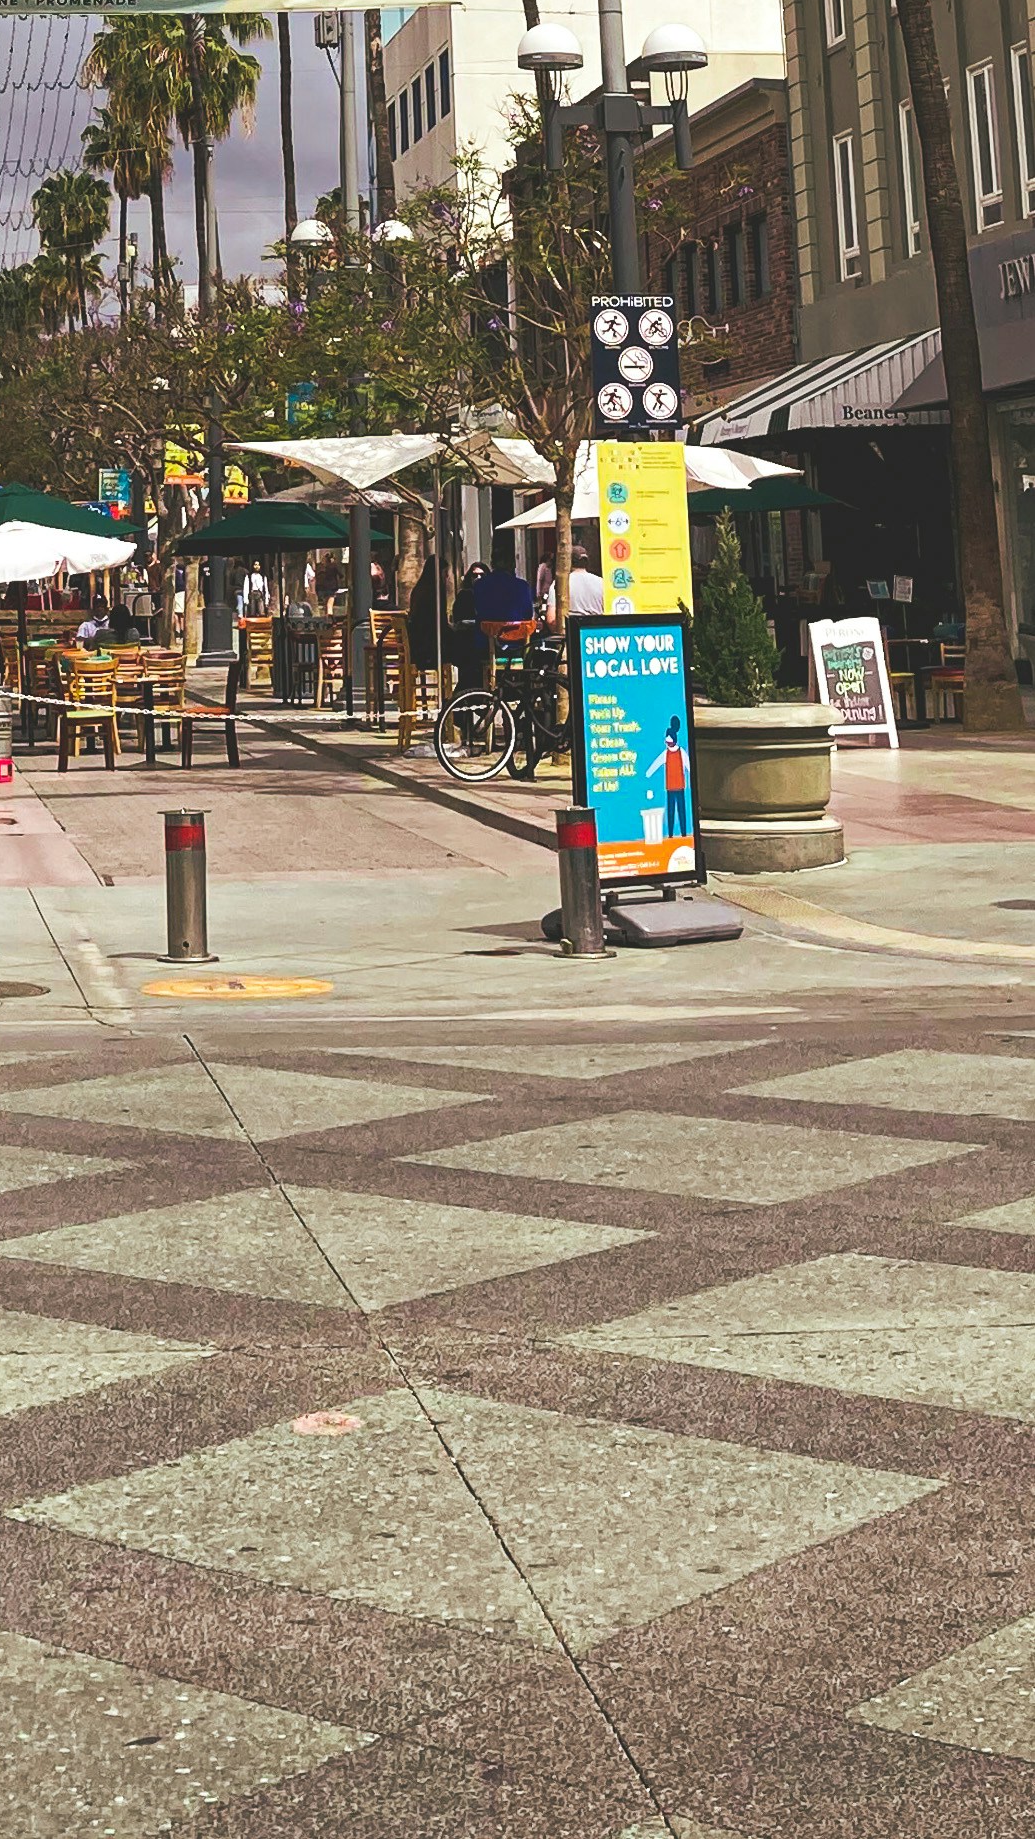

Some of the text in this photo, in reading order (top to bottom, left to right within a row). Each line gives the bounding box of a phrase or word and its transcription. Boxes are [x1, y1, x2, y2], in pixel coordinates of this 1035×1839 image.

[585, 634, 675, 655] SHOW YOUR
[586, 656, 679, 678] LOCAL LOVE
[838, 666, 865, 682] NOW
